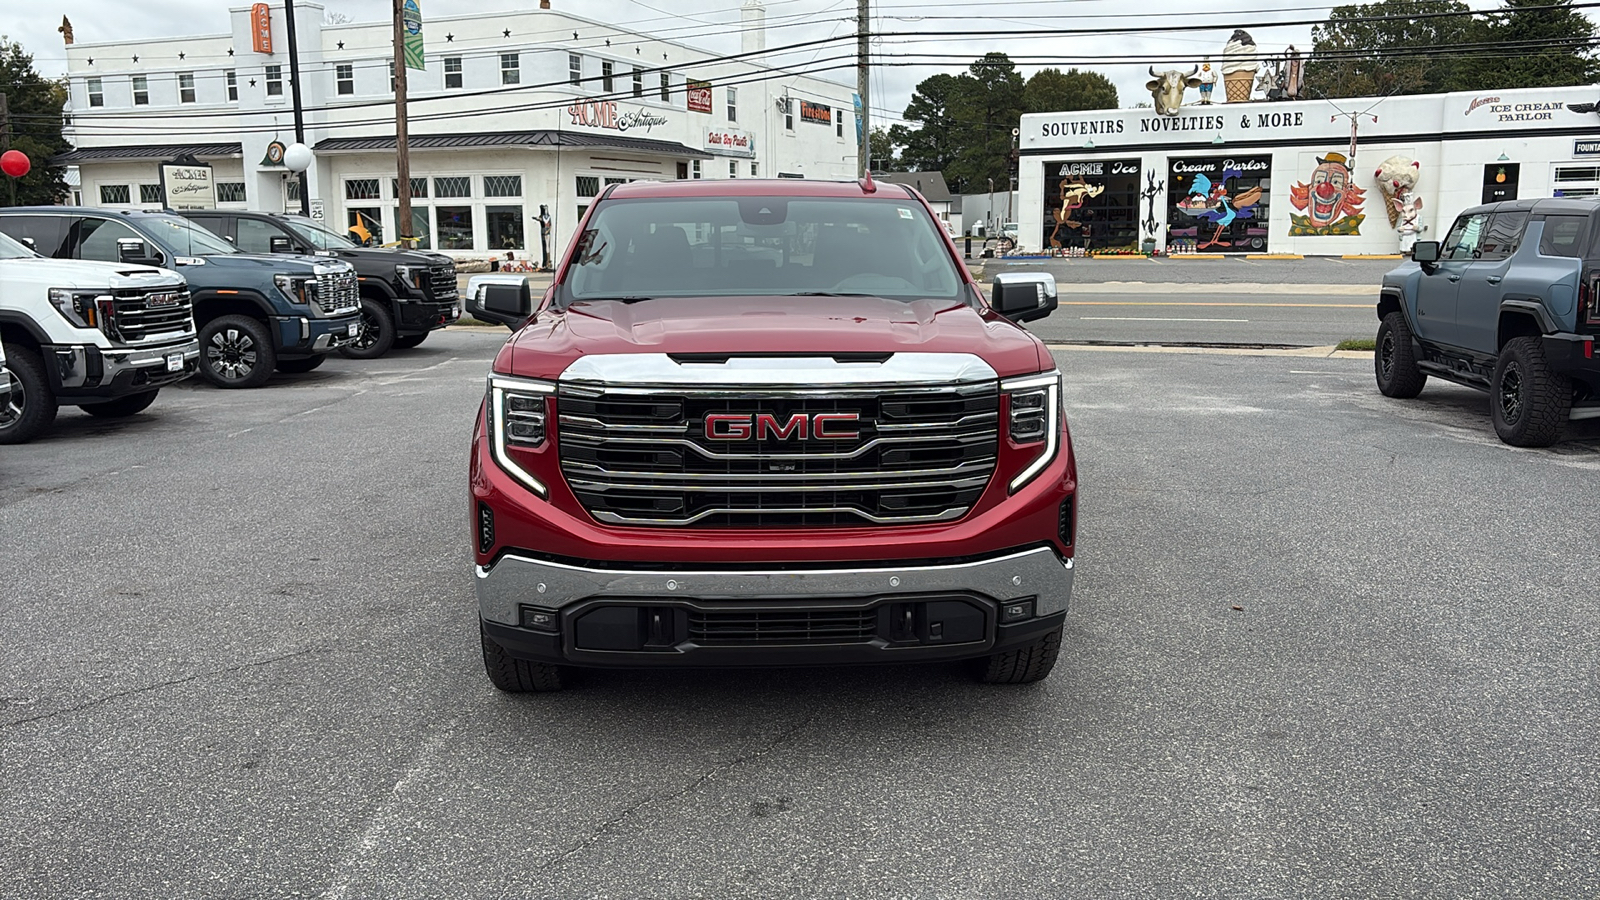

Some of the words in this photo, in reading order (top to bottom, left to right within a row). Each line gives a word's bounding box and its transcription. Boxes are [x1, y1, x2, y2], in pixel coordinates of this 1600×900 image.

[260, 7, 269, 50] ACME
[568, 97, 618, 129] ACME
[618, 107, 668, 133] Antiques
[801, 101, 831, 121] Firestone
[1490, 104, 1512, 113] ICE
[1514, 102, 1564, 112] CREAM
[1042, 119, 1124, 137] SOUVENIRS
[1140, 115, 1224, 132] NOVELTIES
[1240, 114, 1251, 129] &
[1257, 112, 1304, 128] MORE
[1498, 112, 1553, 122] PARLOR
[708, 132, 722, 144] Dutch
[723, 133, 732, 148] Boy
[732, 134, 748, 147] Paints
[1059, 163, 1103, 176] ACME
[1111, 161, 1139, 175] Ice
[1172, 160, 1217, 173] Cream
[1222, 159, 1269, 172] Parlor
[172, 169, 208, 180] ACME
[312, 210, 324, 219] 25
[705, 413, 859, 441] GMC
